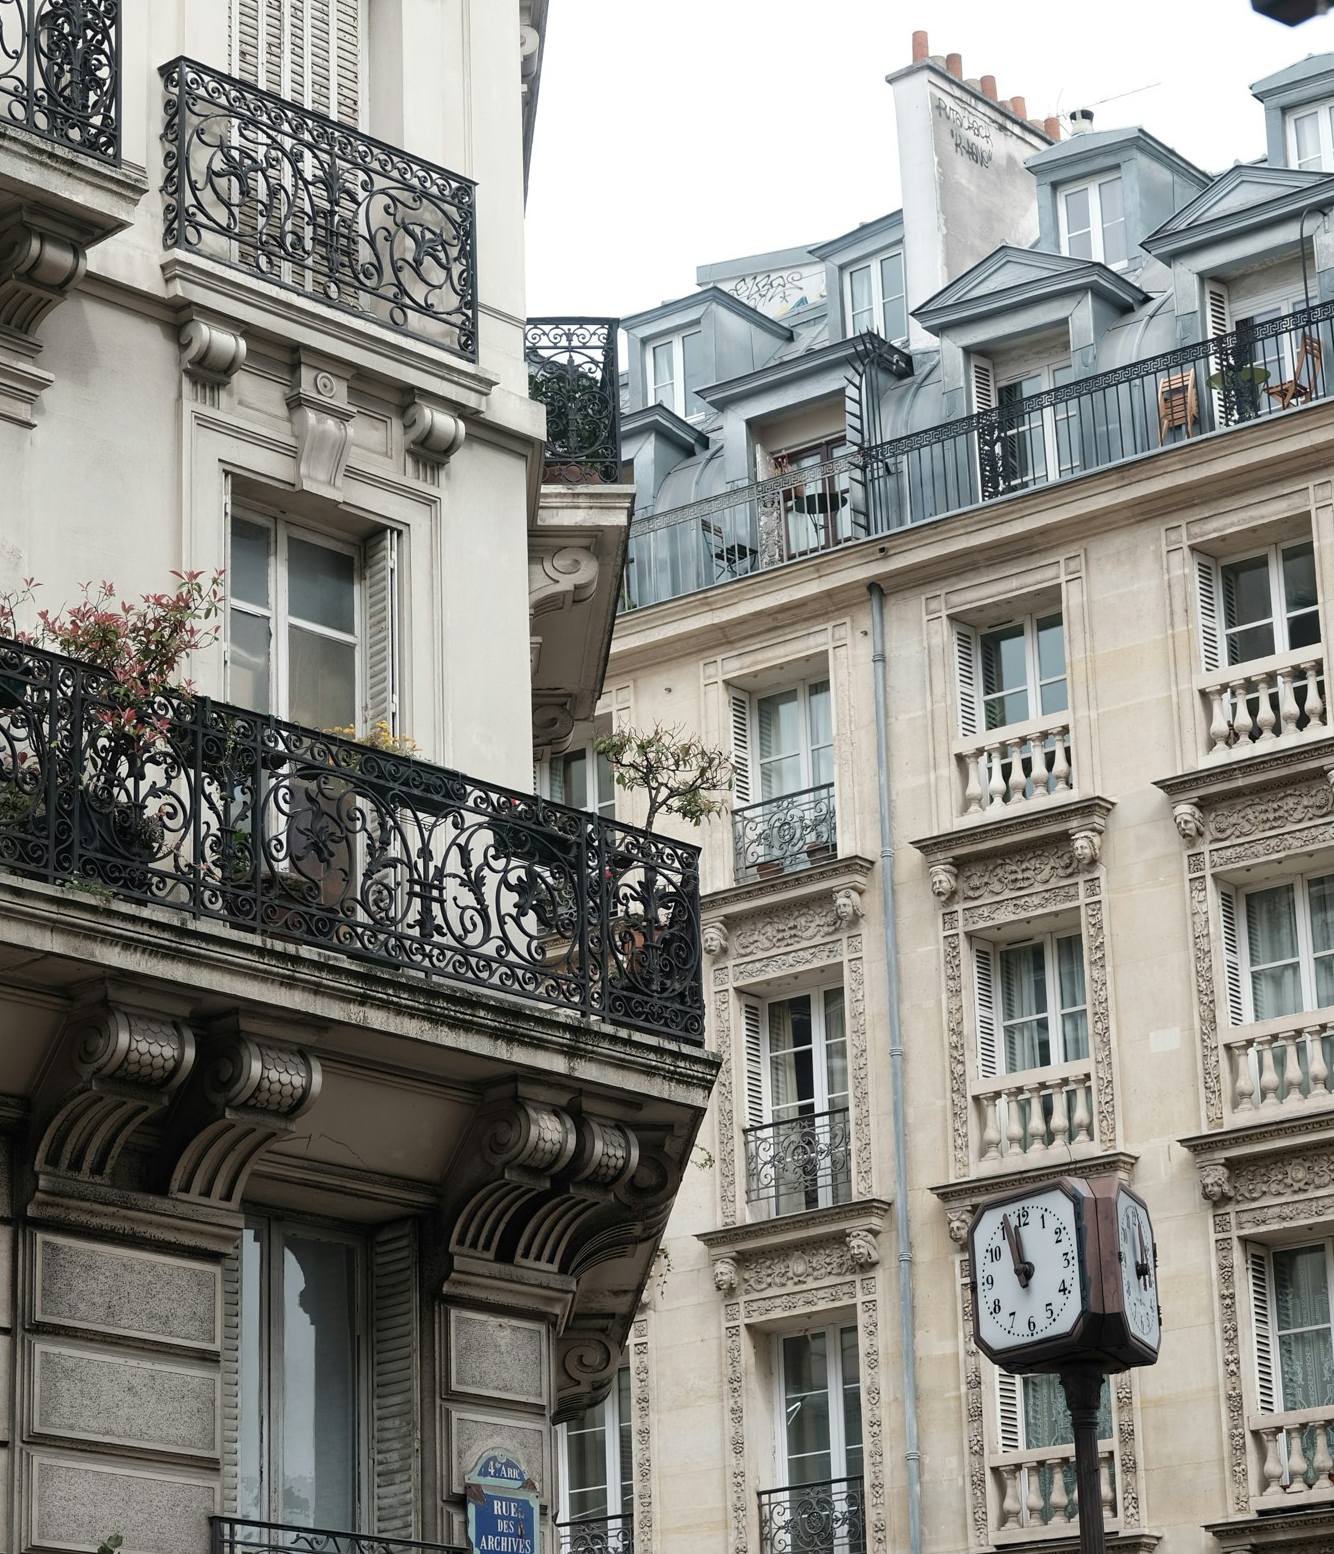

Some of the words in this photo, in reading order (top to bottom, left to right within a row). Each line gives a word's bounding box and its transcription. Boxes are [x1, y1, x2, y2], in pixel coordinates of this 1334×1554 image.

[1016, 1210, 1029, 1228] 12
[1040, 1213, 1046, 1229] 1
[1054, 1227, 1063, 1244] 2
[989, 1245, 1001, 1263] 10
[1062, 1252, 1070, 1268] 3
[986, 1274, 994, 1290] 9
[1058, 1279, 1067, 1295] 4
[993, 1298, 1001, 1314] 8
[1045, 1303, 1053, 1319] 5
[1009, 1311, 1016, 1328] 7
[1028, 1315, 1036, 1332] 6
[493, 1500, 518, 1517] RUE
[497, 1519, 515, 1534] DES
[479, 1535, 532, 1554] ARCHIVES
